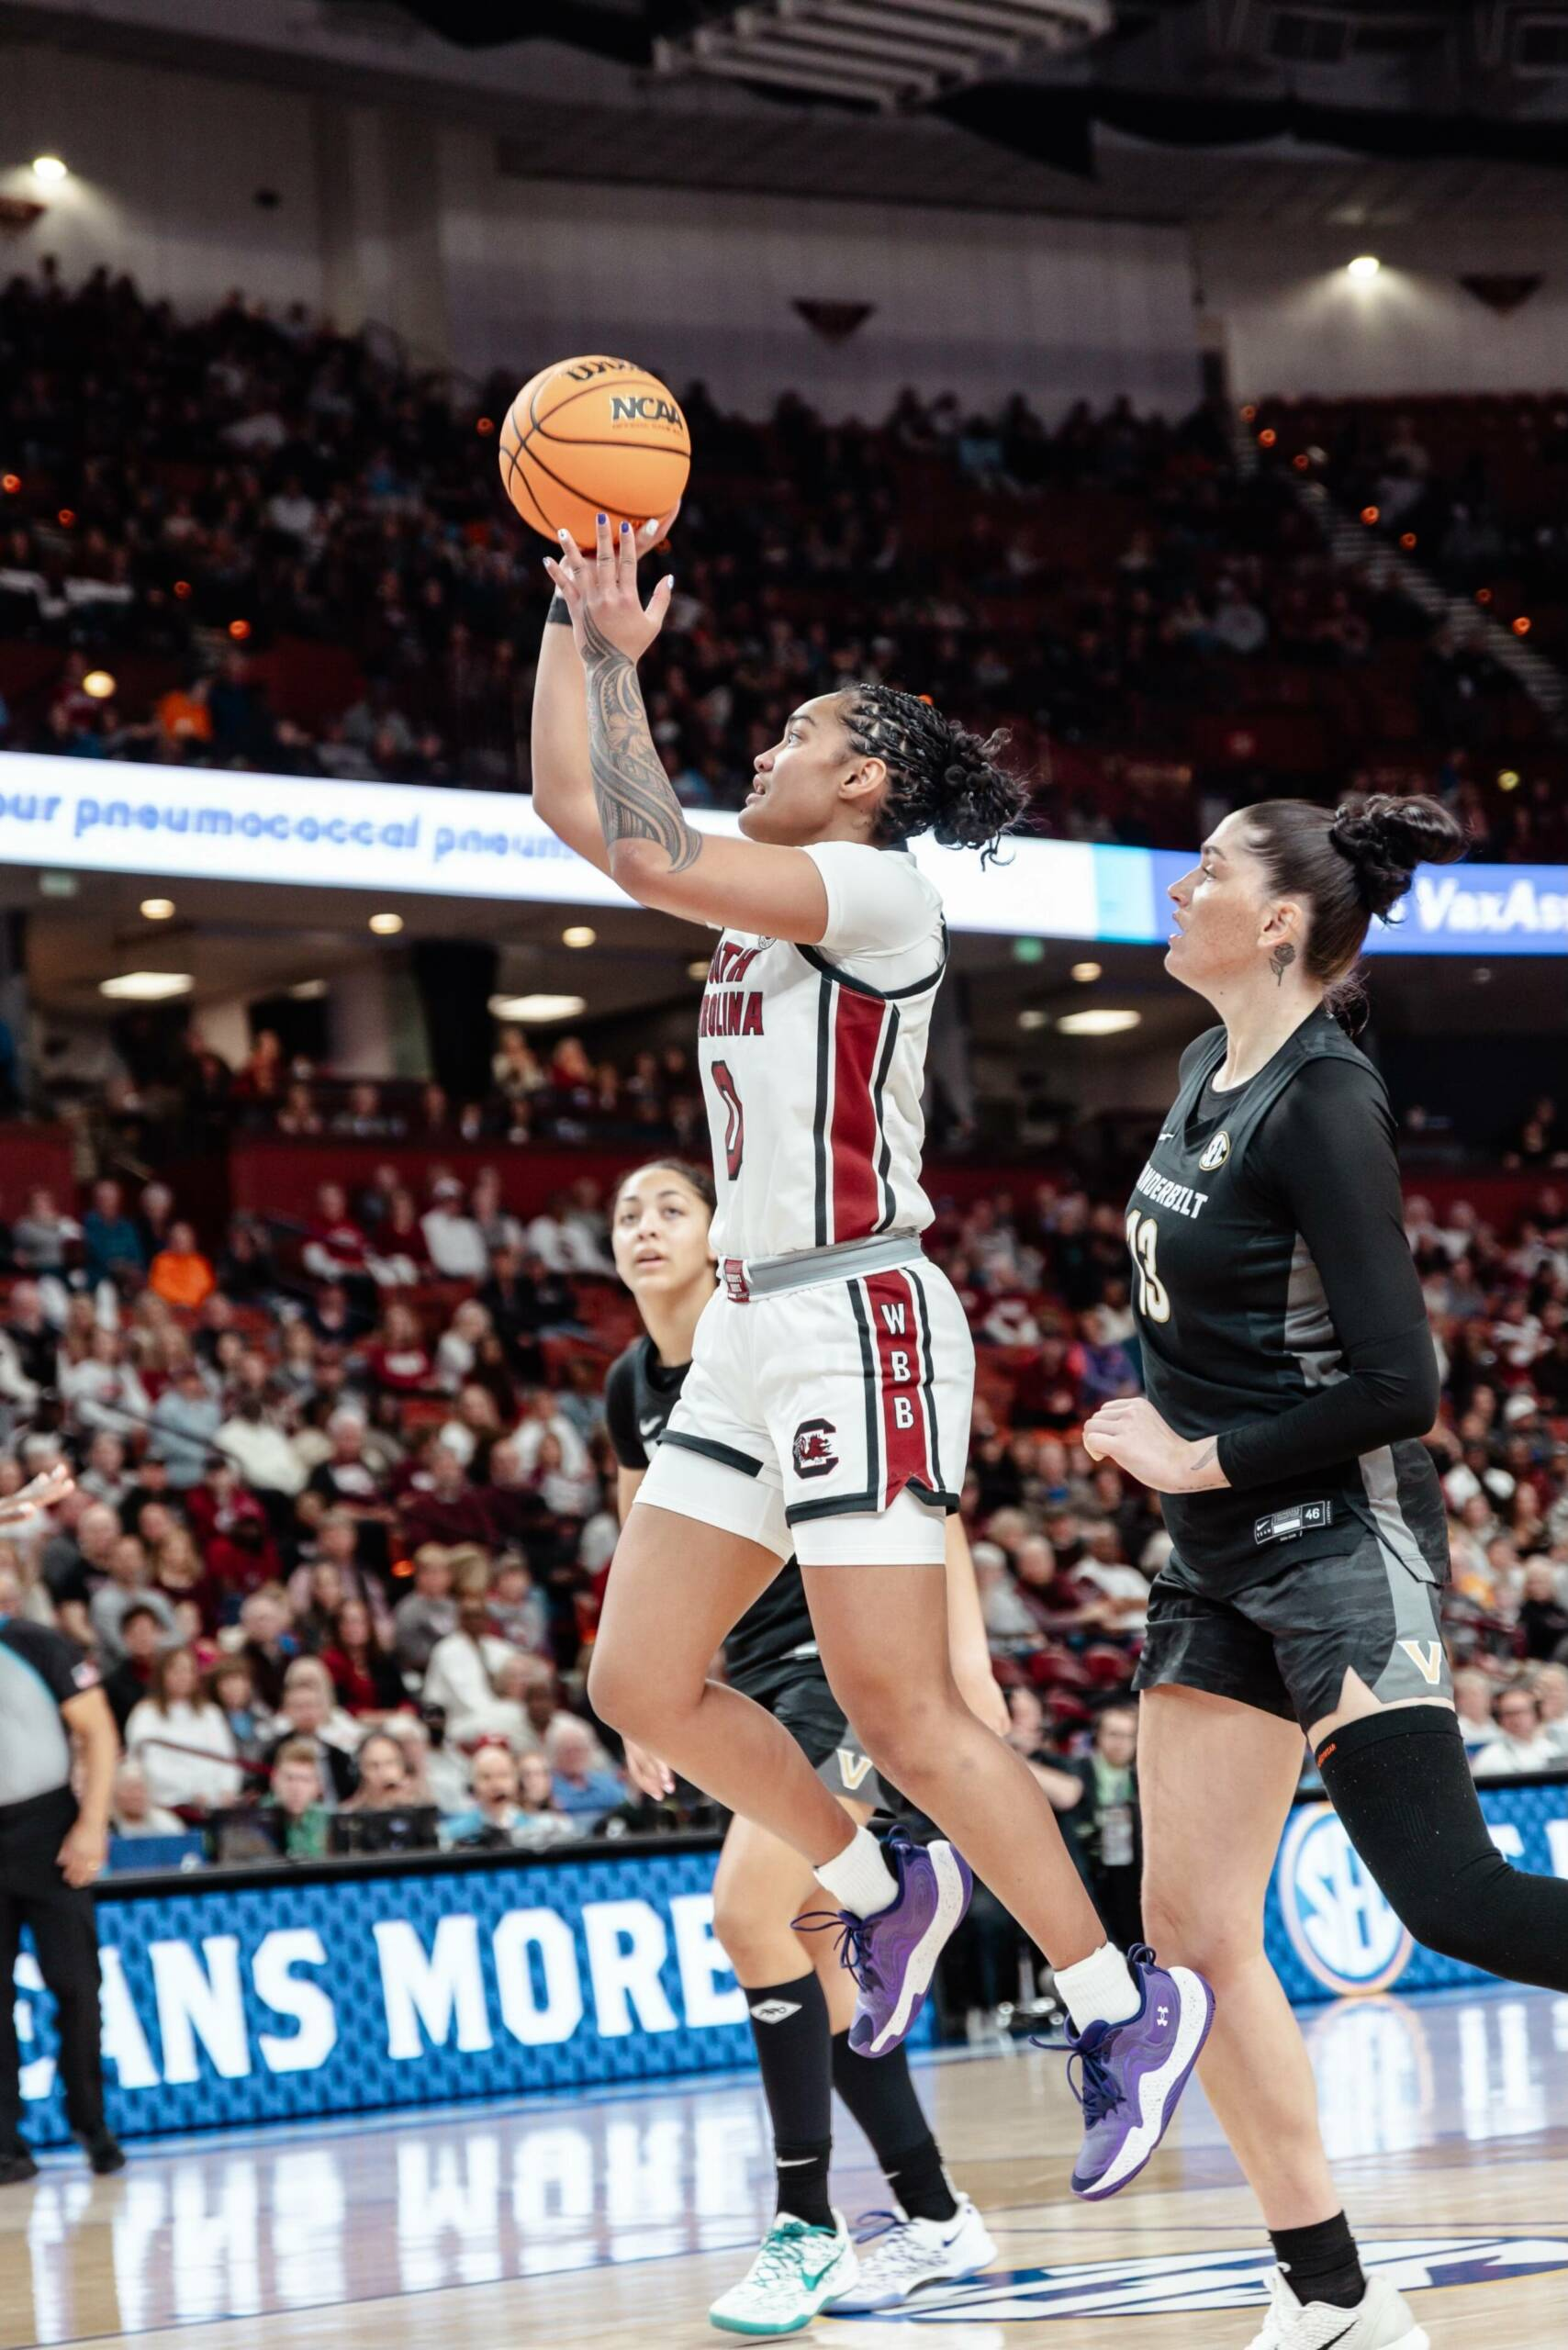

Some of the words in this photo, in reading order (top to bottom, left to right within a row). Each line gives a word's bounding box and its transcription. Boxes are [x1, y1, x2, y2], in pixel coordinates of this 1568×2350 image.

[611, 396, 683, 431] NCAA
[74, 798, 420, 849] pneumococcal
[1415, 876, 1568, 933] VaxAs
[1126, 1209, 1170, 1324] 13
[1305, 1507, 1320, 1520] 46
[1396, 1639, 1442, 1685] V
[836, 1748, 873, 1790] V
[374, 1894, 749, 2059] MORE
